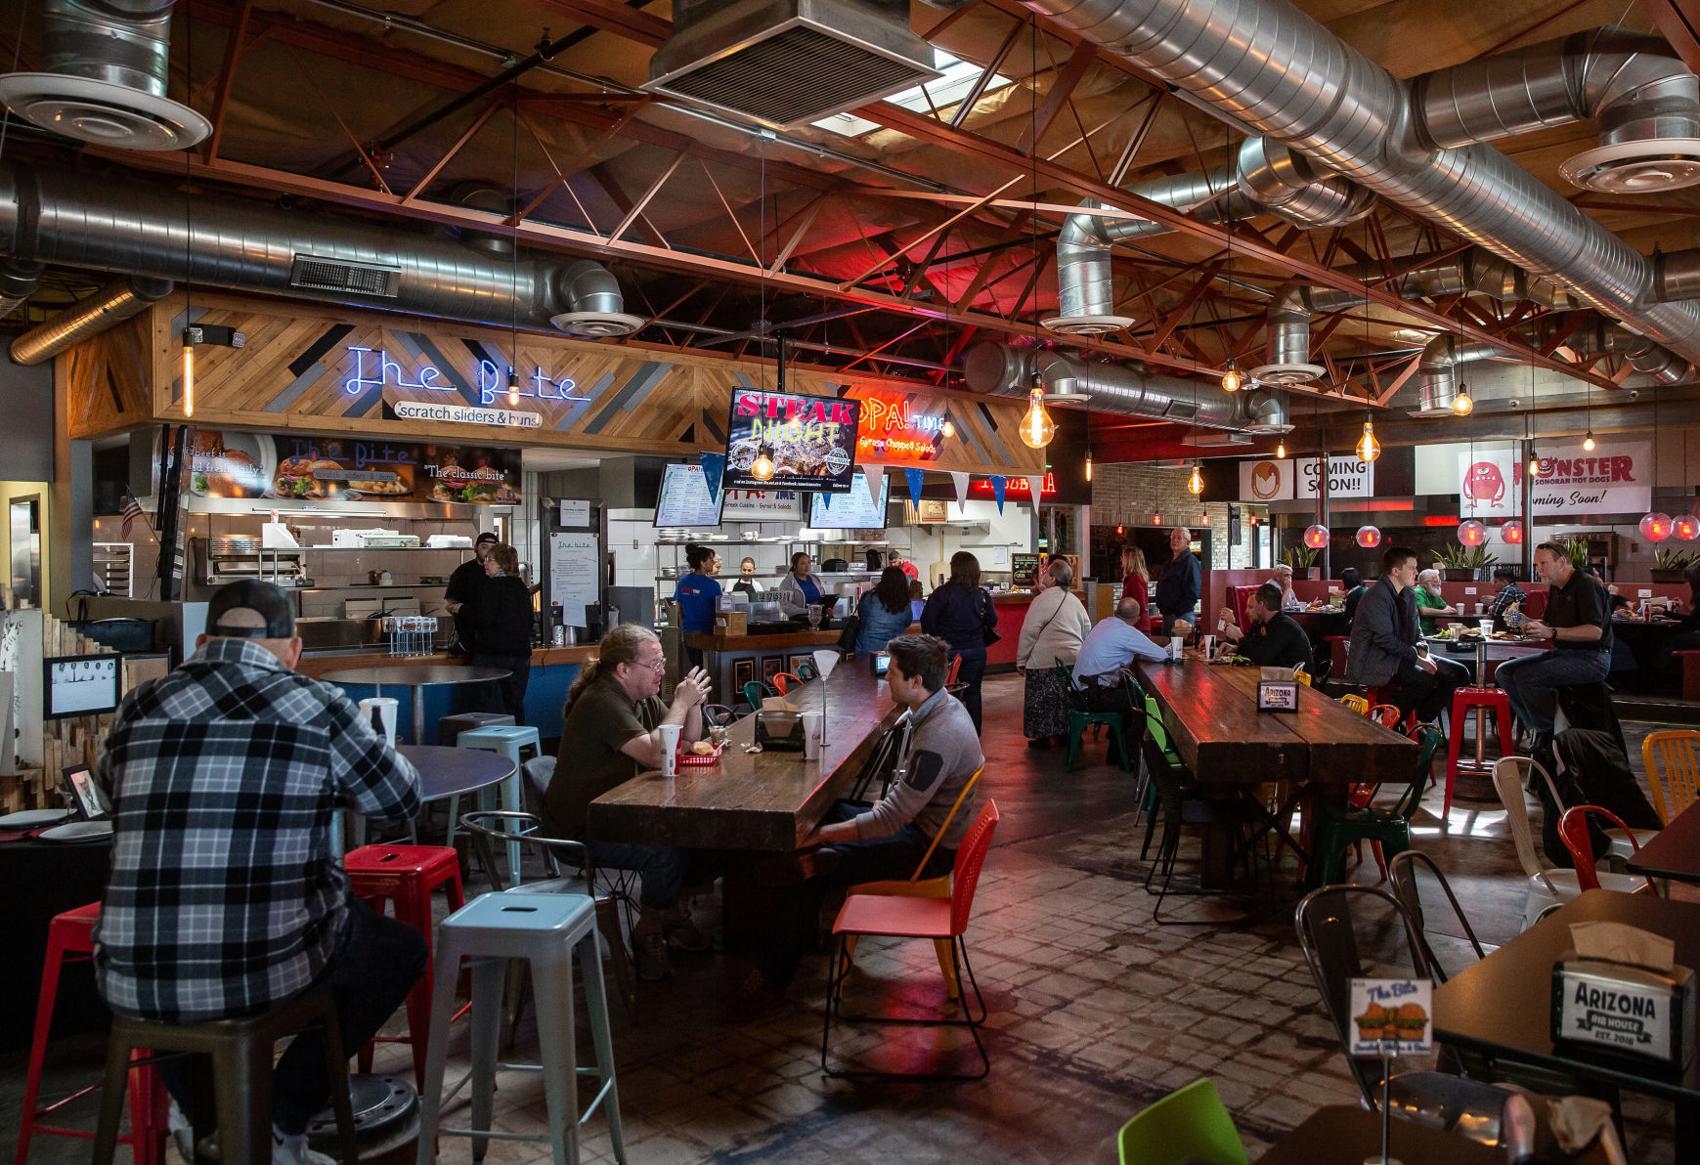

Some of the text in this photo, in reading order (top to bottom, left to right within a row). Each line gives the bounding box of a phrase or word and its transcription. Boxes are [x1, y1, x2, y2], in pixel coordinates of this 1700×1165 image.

[346, 346, 457, 394] The
[400, 405, 451, 420] scratch
[454, 410, 495, 424] sliders
[497, 412, 506, 424] &
[737, 393, 855, 425] STEAK
[751, 417, 841, 447] NIGHT
[355, 441, 417, 470] Bite
[451, 466, 484, 479] classic
[1308, 478, 1361, 492] SON!!
[1568, 489, 1607, 506] Soon!
[1264, 686, 1291, 697] ARIZONA
[1574, 981, 1657, 1020] ARIZONA
[1608, 1016, 1640, 1031] HOUSE
